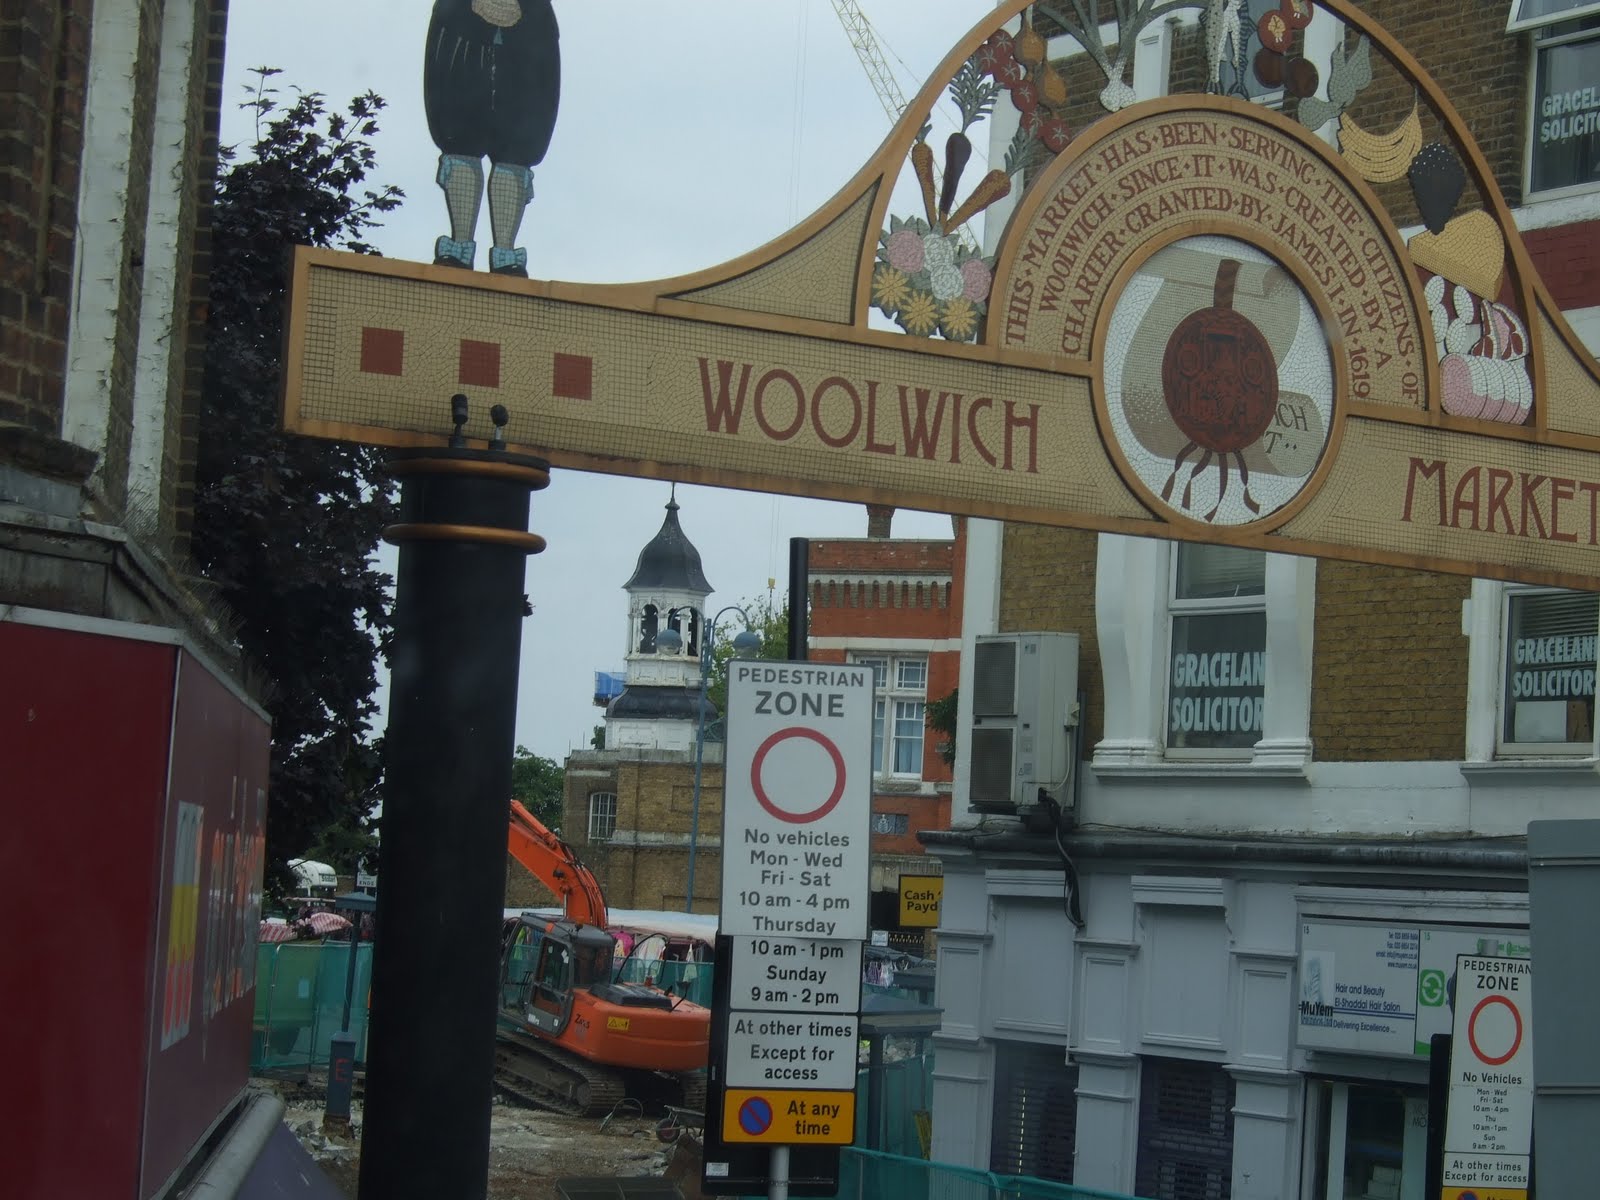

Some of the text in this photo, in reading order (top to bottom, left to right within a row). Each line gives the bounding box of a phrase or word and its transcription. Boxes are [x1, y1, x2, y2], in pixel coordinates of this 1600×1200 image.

[1541, 87, 1600, 117] GRACEL
[1238, 192, 1271, 224] BY
[1271, 213, 1337, 287] JAMES
[1006, 277, 1034, 345] THIS
[1022, 161, 1098, 269] MARKET
[1099, 130, 1152, 173] HAS
[1158, 121, 1218, 149] BEEN
[1321, 179, 1363, 234] THE
[1361, 237, 1415, 358] CITIZENS
[1401, 372, 1419, 405] OF
[1038, 154, 1393, 370] WOOLWICH SINCE IT WAS CREATED BY A
[1062, 230, 1126, 355] CHARTER
[1337, 303, 1363, 338] IN
[1348, 345, 1371, 399] 1619
[696, 356, 1042, 474] WOOLWICH
[1400, 456, 1600, 546] MARKET
[738, 667, 864, 688] PEDESTRIAN
[1512, 669, 1596, 698] SOLICITOR
[755, 690, 845, 718] ZONE
[744, 829, 850, 847] No vehicles
[750, 850, 788, 866] Mon
[804, 852, 843, 868] Wed
[761, 870, 784, 885] Fri
[800, 871, 831, 887] Sat
[740, 891, 760, 906] 10
[765, 895, 791, 907] am
[806, 893, 818, 908] 4
[823, 897, 849, 911] pm
[904, 890, 934, 901] Cash
[753, 916, 836, 936] Thursday
[751, 940, 769, 955] 10
[773, 944, 796, 956] am
[820, 946, 844, 960] pm
[766, 965, 827, 984] Sunday
[1464, 960, 1531, 975] PEDESTRIAN
[1335, 983, 1385, 997] Hair and Beauty
[1477, 975, 1519, 991] ZONE
[751, 986, 761, 1001] 9
[765, 990, 788, 1002] am
[801, 988, 811, 1003] 2
[815, 992, 839, 1006] pm
[1301, 1001, 1333, 1017] MuYem
[1369, 1000, 1381, 1010] Hair
[1383, 1001, 1401, 1012] Salon
[735, 1019, 852, 1037] At other times
[1333, 1020, 1360, 1032] Delivering
[1361, 1022, 1390, 1033] Excellence
[750, 1044, 835, 1062] Except for
[764, 1067, 818, 1080] access
[1462, 1072, 1522, 1085] No Vehicles
[787, 1100, 840, 1118] At any
[796, 1120, 830, 1135] time
[1453, 1160, 1521, 1171] At other times
[1445, 1171, 1527, 1182] Except for access
